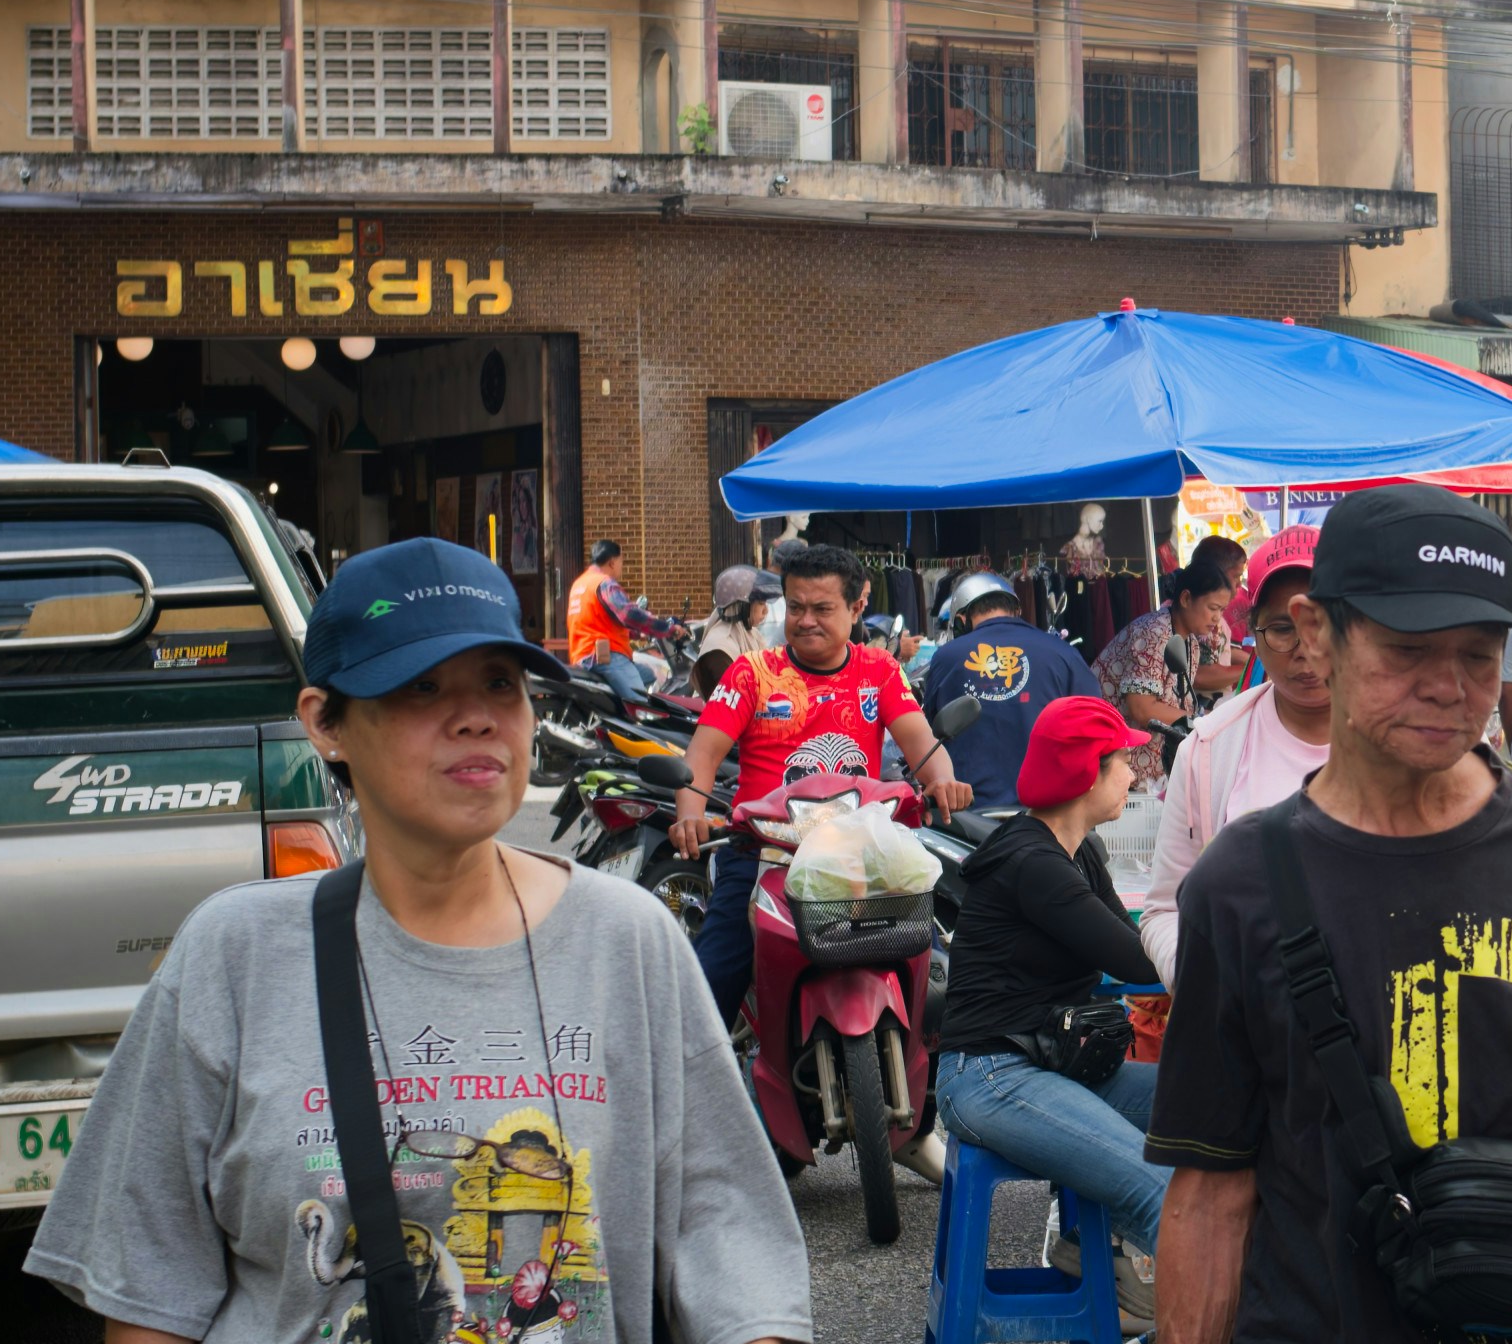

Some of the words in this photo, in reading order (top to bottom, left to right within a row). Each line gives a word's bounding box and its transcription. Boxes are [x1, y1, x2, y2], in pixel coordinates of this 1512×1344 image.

[1266, 490, 1346, 506] BNNET
[1266, 544, 1316, 568] BERLI
[1417, 544, 1506, 578] GARMIN
[963, 642, 1025, 689] 輝
[755, 710, 792, 721] PEPSI
[69, 780, 243, 815] STRADA
[366, 1024, 593, 1067] 金三角
[303, 1076, 440, 1114] GDEN
[450, 1072, 608, 1104] TRIANGLE
